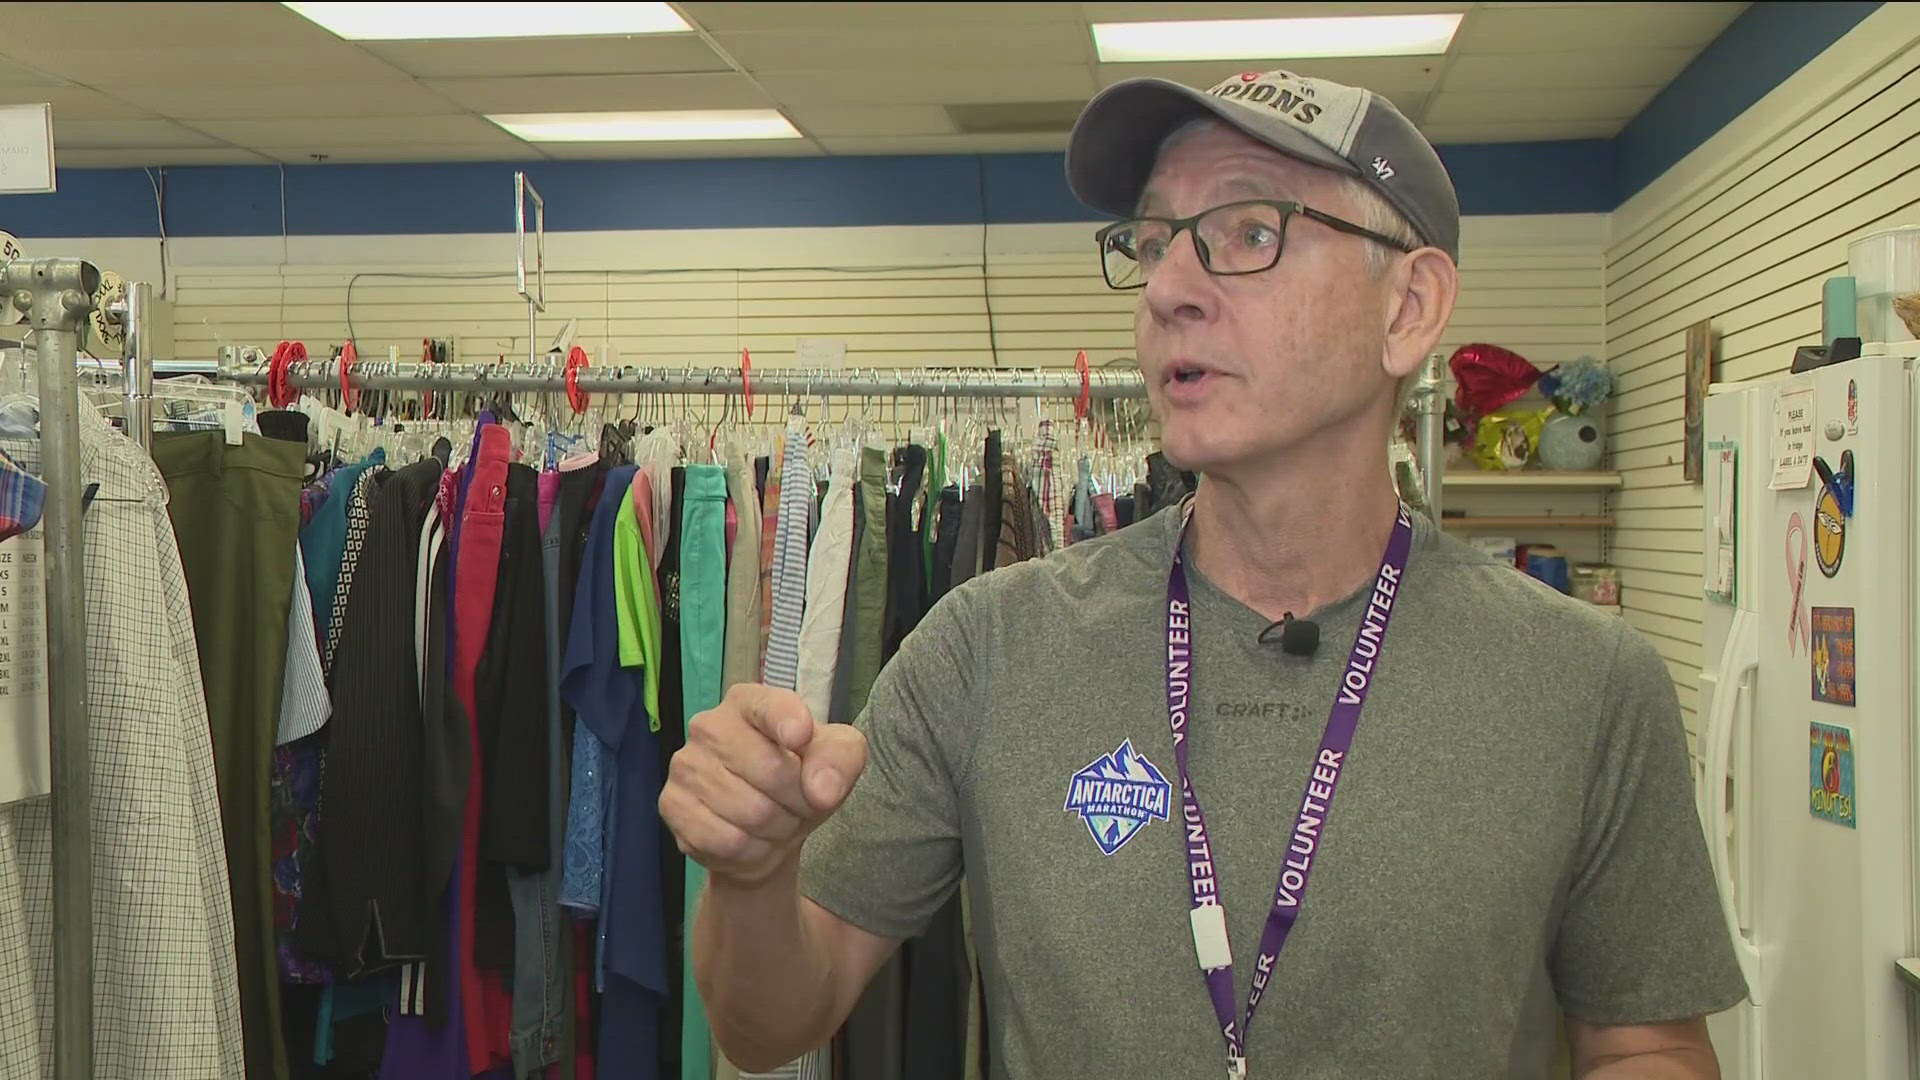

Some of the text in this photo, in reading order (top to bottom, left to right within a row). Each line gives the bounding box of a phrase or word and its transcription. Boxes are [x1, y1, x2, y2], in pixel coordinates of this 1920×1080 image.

[1, 586, 7, 596] S
[0, 603, 9, 613] M
[3, 619, 8, 630] L
[1339, 563, 1401, 706] VOLUNTEER
[1168, 599, 1189, 746] VOLUNTEER
[1215, 703, 1290, 717] CRAFT
[1071, 778, 1166, 814] ANTARCTICA
[1086, 804, 1145, 818] MARATHON
[1277, 746, 1343, 908] VOLUNTEER
